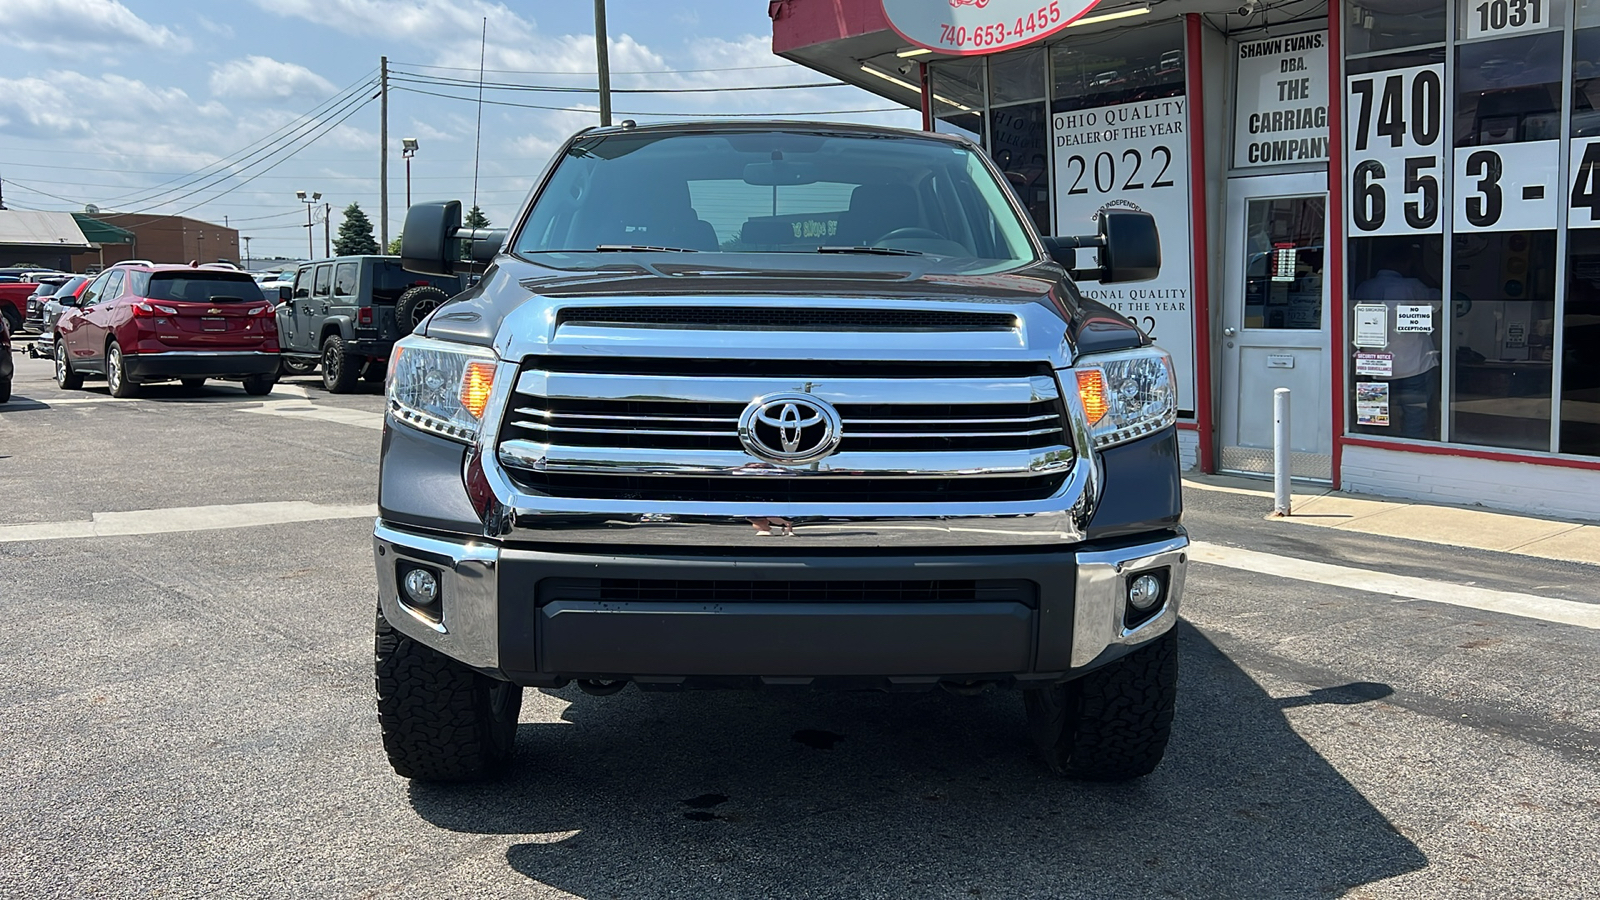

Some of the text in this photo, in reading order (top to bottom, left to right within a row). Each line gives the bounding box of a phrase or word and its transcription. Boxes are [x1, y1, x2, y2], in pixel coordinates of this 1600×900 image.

[940, 1, 1060, 46] 740-653-4455
[1476, 0, 1540, 32] 1031
[1240, 34, 1324, 59] SHAWN EVANS.
[1280, 57, 1307, 73] DBA.
[1277, 78, 1309, 101] THE
[1054, 100, 1184, 130] OHIO QUALITY
[1249, 105, 1329, 134] CARRIAG
[1351, 70, 1441, 151] 740
[1057, 131, 1101, 147] DEALER
[1104, 129, 1119, 142] OF
[1122, 126, 1146, 139] THE
[1149, 121, 1183, 136] YEAR
[1067, 145, 1174, 195] 2022
[1105, 199, 1142, 211] INDEPENDE
[1109, 302, 1186, 311] OF THE YEAR
[1129, 289, 1187, 300] QUALITY
